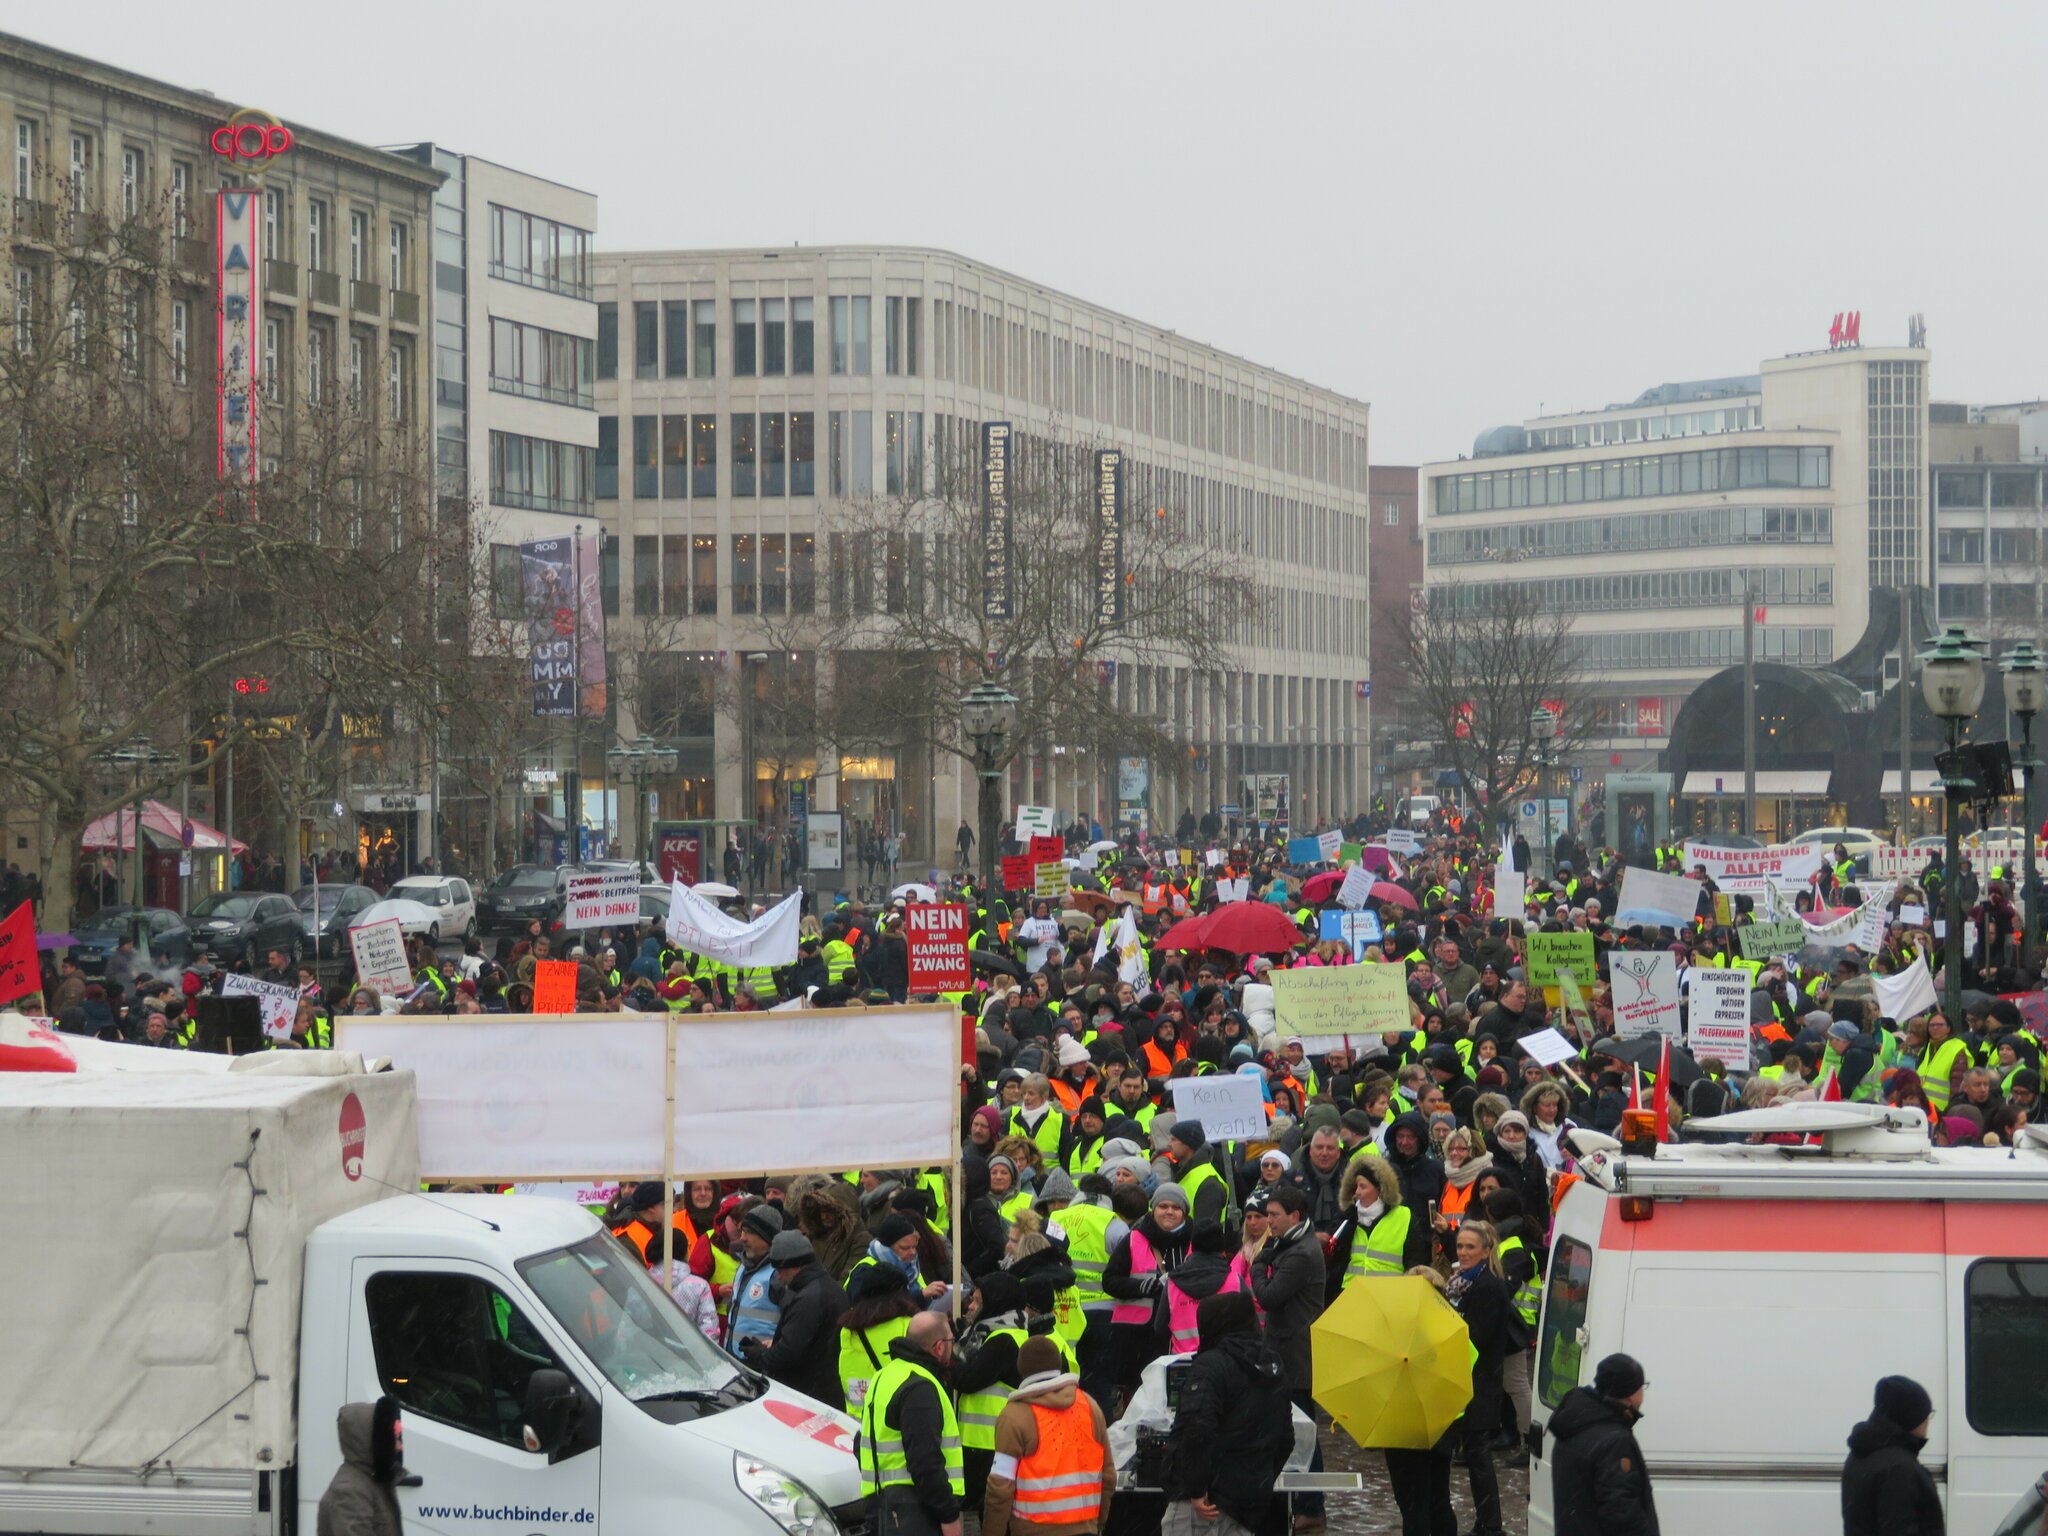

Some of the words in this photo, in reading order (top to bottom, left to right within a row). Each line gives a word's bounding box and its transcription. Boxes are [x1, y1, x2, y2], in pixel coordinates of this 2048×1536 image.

[212, 123, 290, 160] GOP
[224, 193, 250, 500] VARIET
[663, 840, 698, 852] KFC
[1692, 845, 1810, 861] VOLLBEFRAGUNG
[576, 905, 601, 919] NEIN
[605, 903, 637, 917] DANKE
[910, 909, 963, 930] NEIN
[928, 933, 947, 941] zum
[912, 943, 964, 955] KAMMER
[1532, 939, 1546, 951] Wir
[1550, 939, 1582, 951] brauchen
[912, 957, 966, 972] ZWANG
[1701, 971, 1745, 983] EINSCHÜCHTERN
[1715, 986, 1745, 996] BEDROHEN
[1721, 998, 1745, 1008] NÖTIGEN
[1714, 1010, 1745, 1020] ERPRESSEN
[1698, 1027, 1745, 1039] PFLEGEKAMMER
[1192, 1088, 1233, 1105] Kein
[1203, 1115, 1257, 1137] wang
[418, 1504, 595, 1523] www.buchbinder.de
